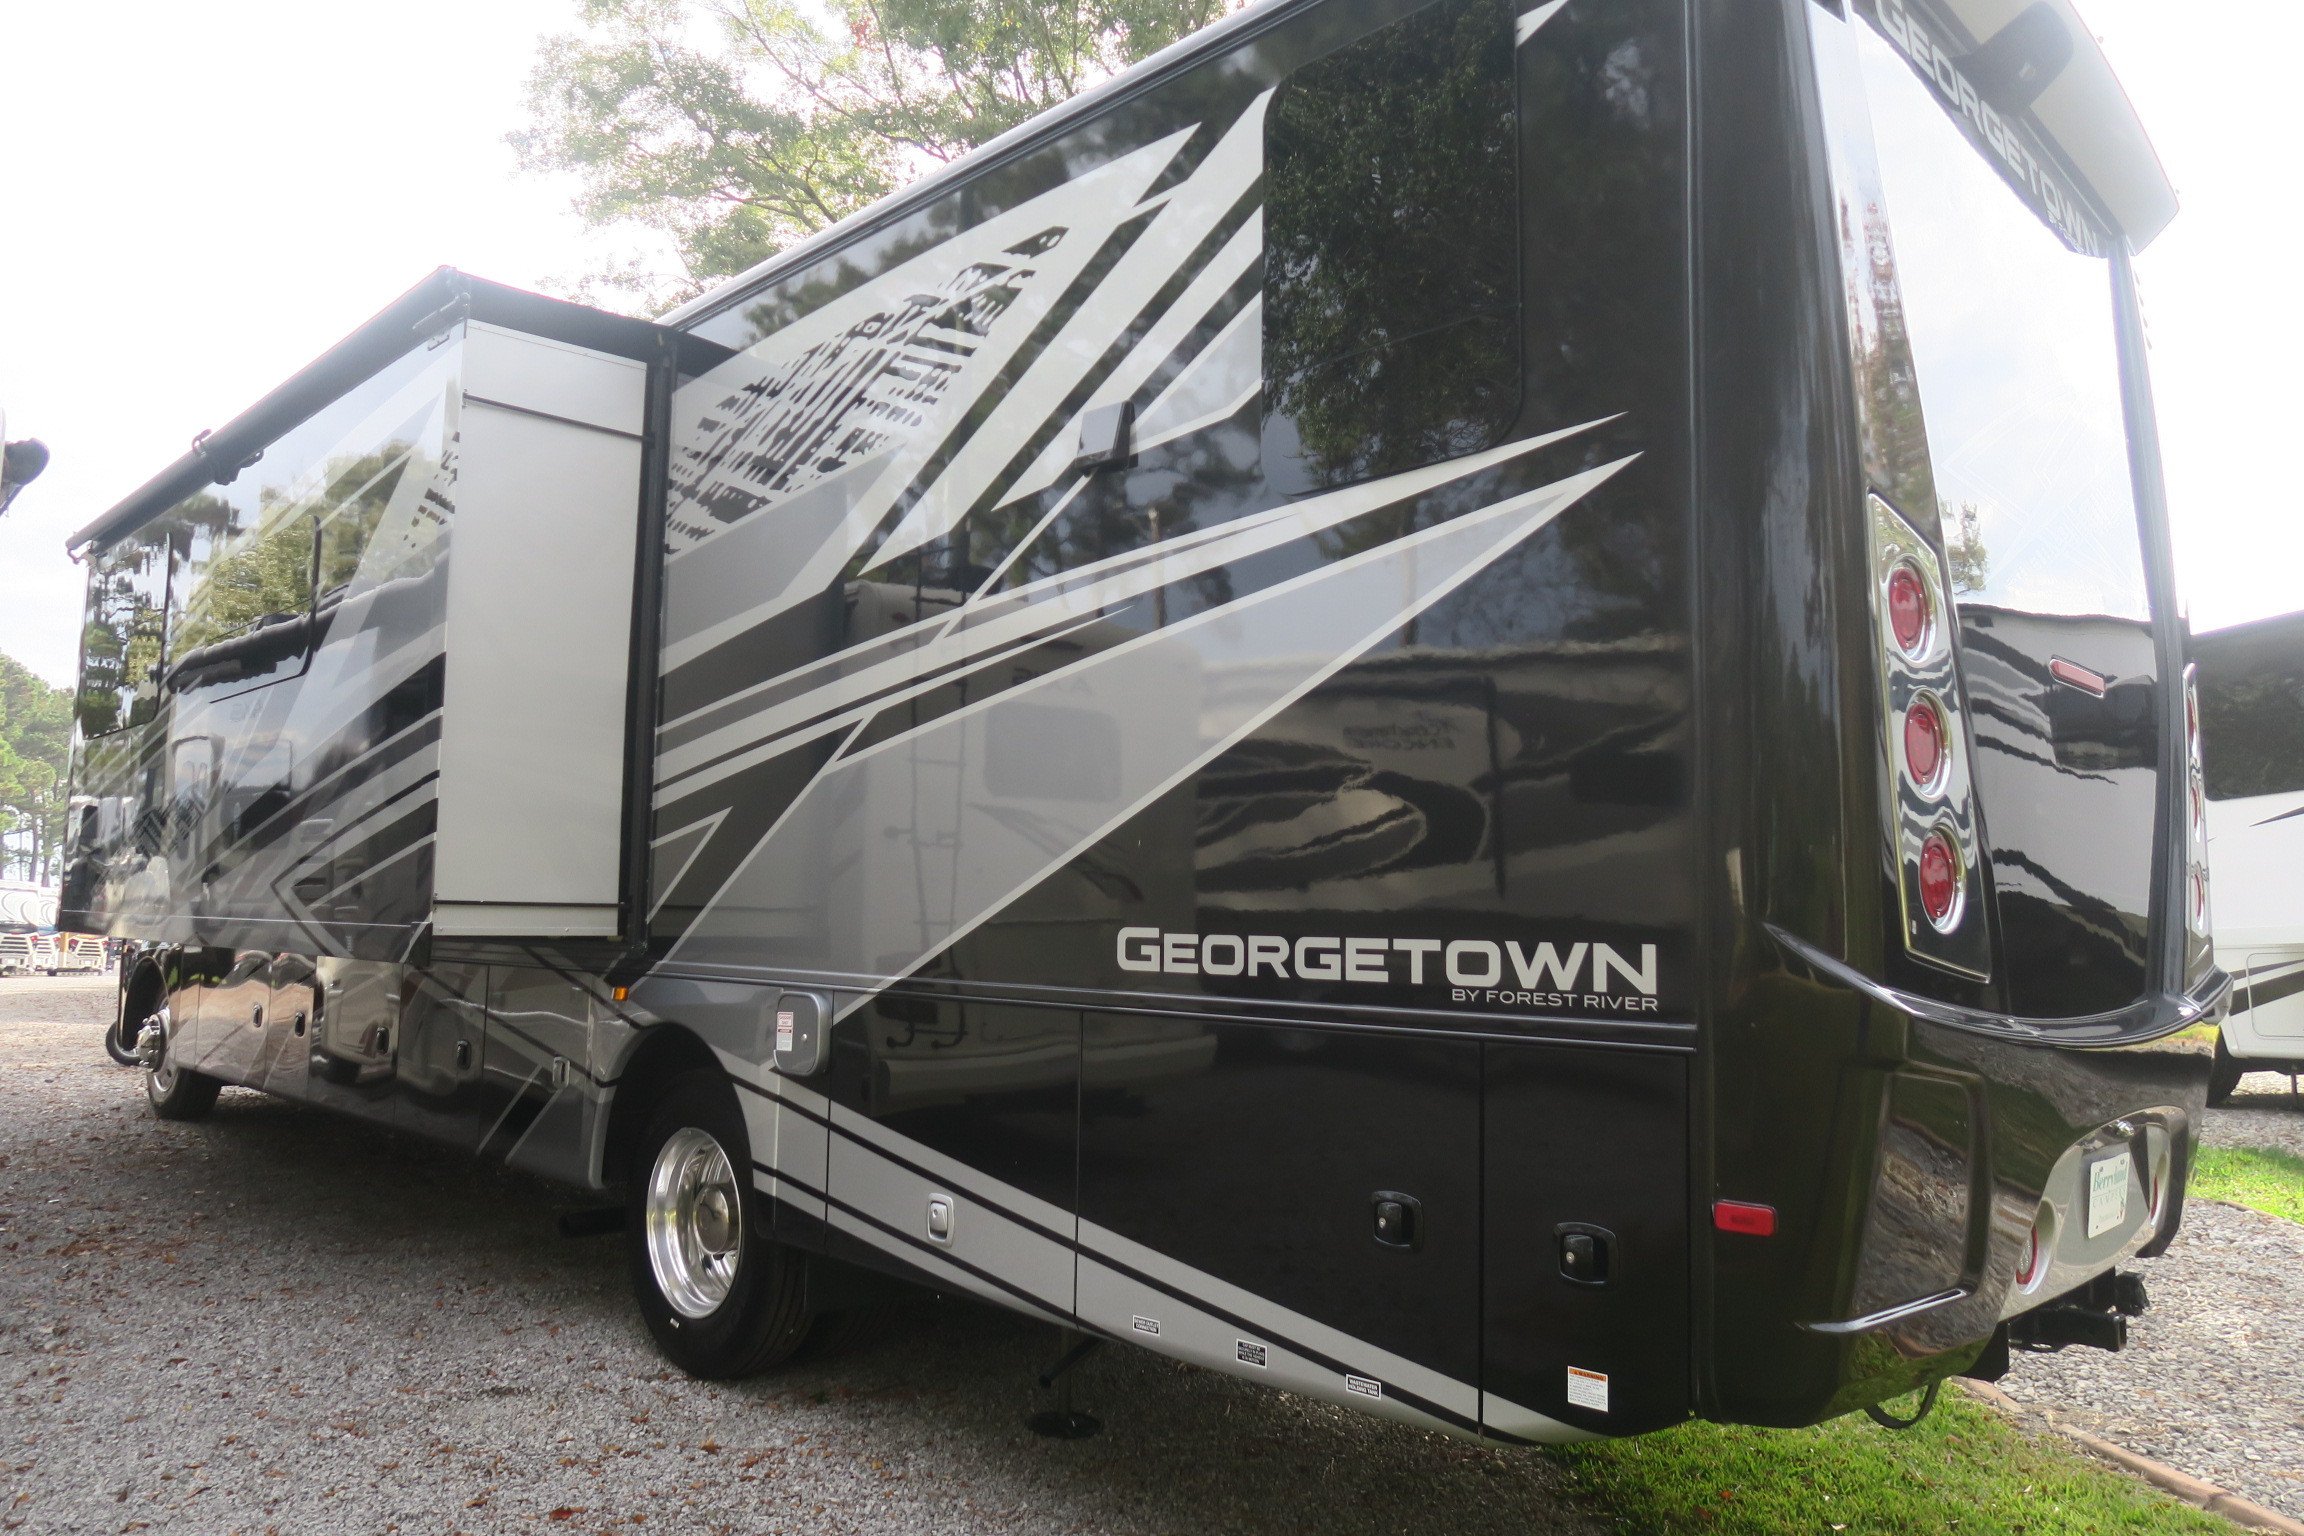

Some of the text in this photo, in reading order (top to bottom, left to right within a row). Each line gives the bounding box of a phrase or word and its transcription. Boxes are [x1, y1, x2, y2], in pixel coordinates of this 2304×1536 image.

[1874, 0, 2100, 257] GEORGETOWN
[1116, 926, 1658, 995] GEORGETOWN
[1451, 988, 1658, 1012] BY FOREST RIVER
